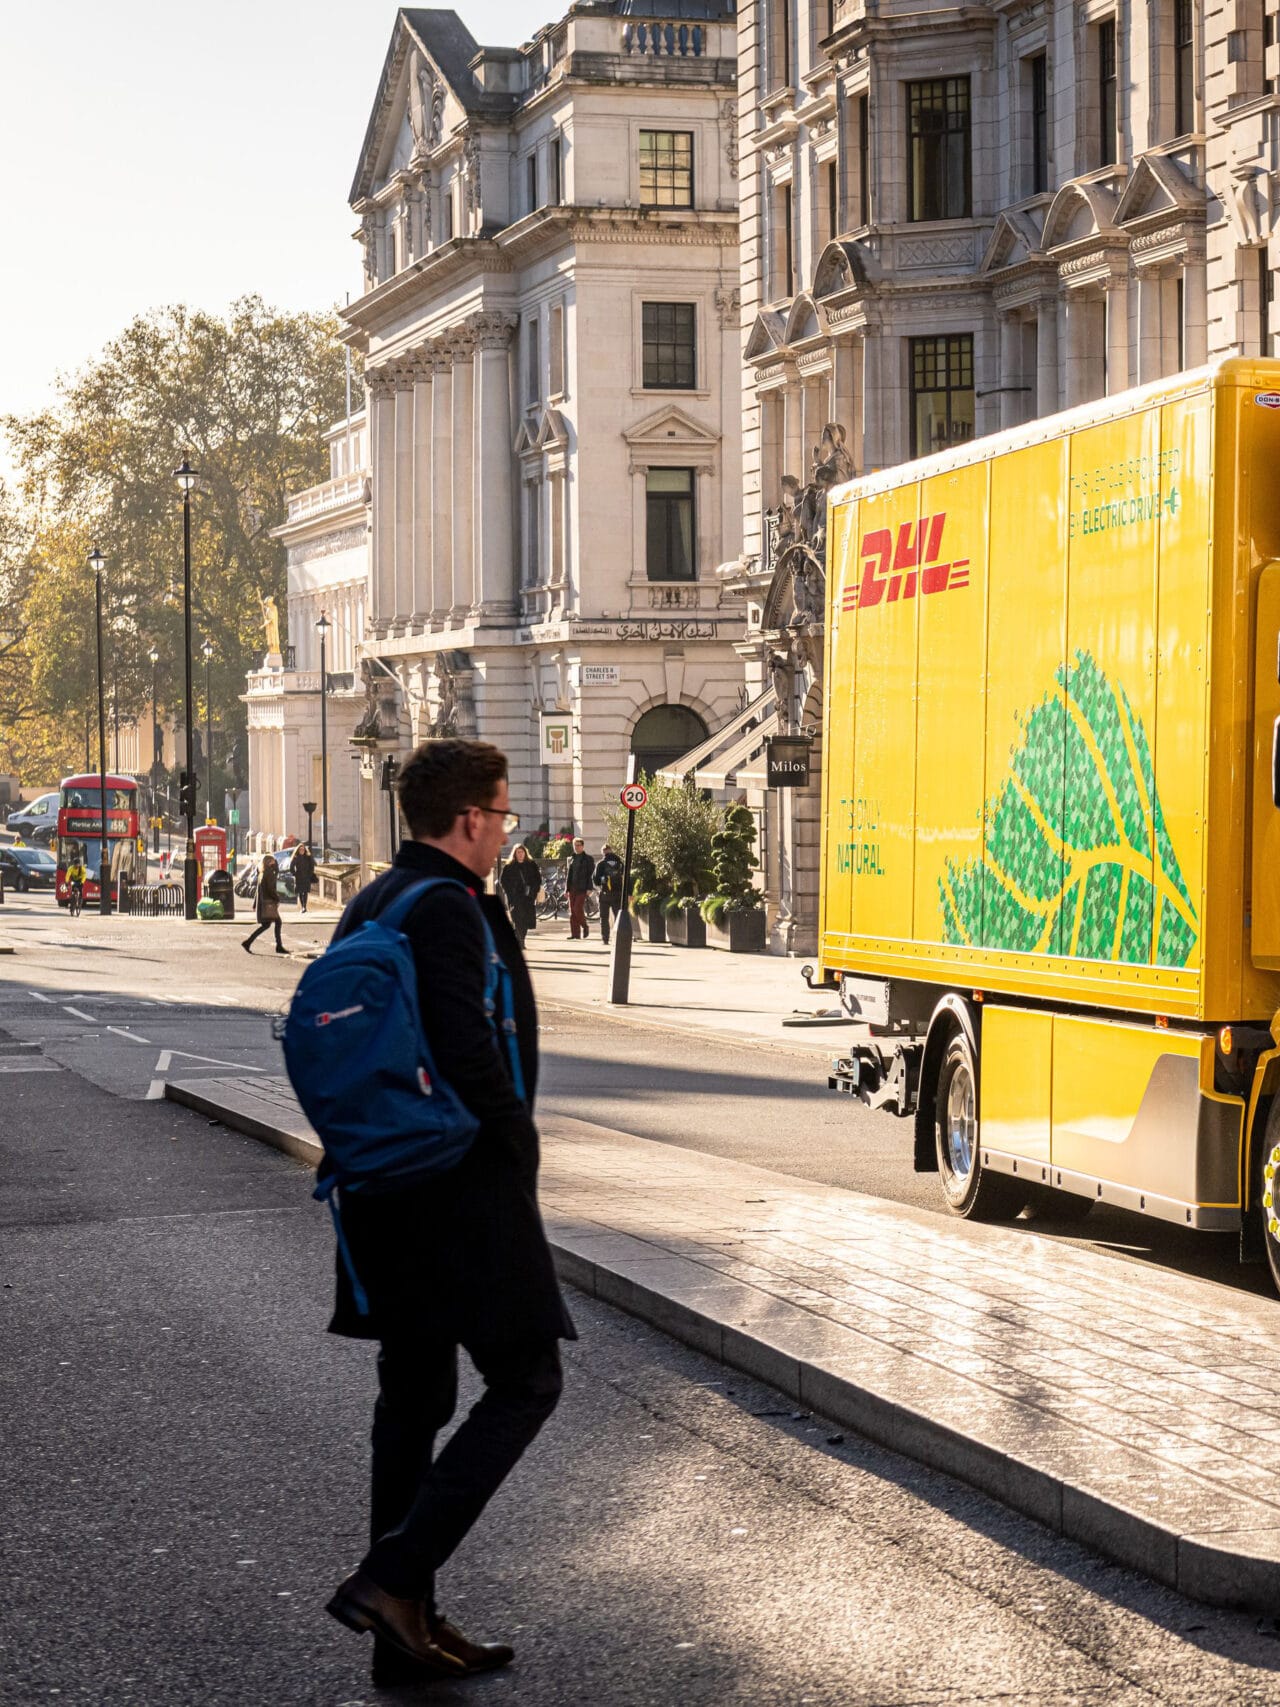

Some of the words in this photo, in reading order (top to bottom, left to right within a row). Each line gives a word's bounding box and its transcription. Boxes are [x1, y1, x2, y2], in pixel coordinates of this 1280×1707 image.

[1082, 500, 1127, 535] ELECTRIC
[1129, 493, 1162, 524] DRIVE
[858, 512, 951, 608] DHL
[771, 760, 807, 773] Milos
[626, 791, 644, 802] 20
